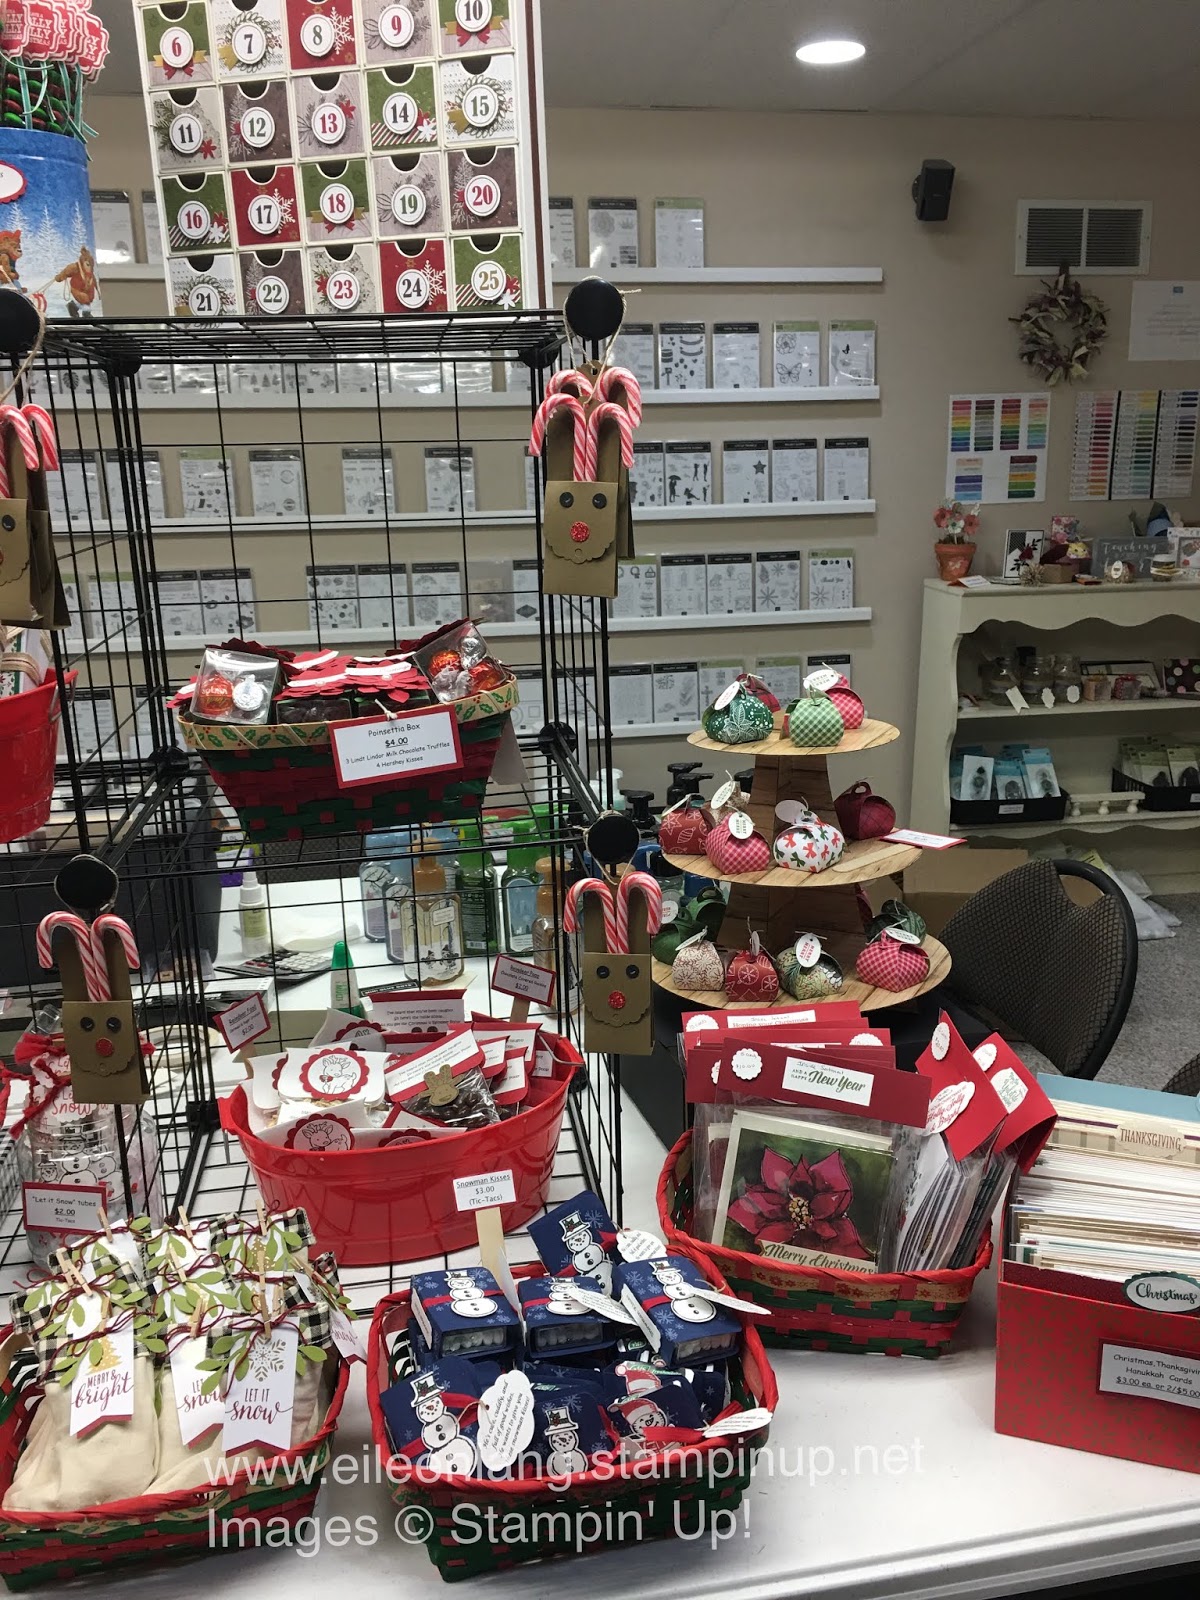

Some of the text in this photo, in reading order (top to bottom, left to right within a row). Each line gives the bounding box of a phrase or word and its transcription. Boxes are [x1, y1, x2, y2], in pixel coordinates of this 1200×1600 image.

[464, 0, 483, 22] 10
[312, 24, 323, 46] 8
[391, 15, 402, 36] 9
[171, 37, 182, 57] 6
[243, 33, 254, 54] 7
[390, 102, 409, 124] 14
[470, 95, 490, 117] 15
[178, 123, 194, 144] 11
[248, 117, 266, 138] 12
[320, 113, 338, 134] 13
[328, 193, 346, 213] 18
[400, 194, 418, 214] 19
[472, 184, 494, 206] 20
[185, 210, 202, 230] 16
[256, 204, 272, 224] 17
[334, 280, 354, 299] 23
[402, 278, 422, 298] 24
[478, 270, 500, 290] 25
[196, 292, 212, 312] 21
[262, 284, 282, 302] 22
[368, 726, 404, 737] Poinsettia
[385, 737, 408, 748] $4.00
[399, 746, 426, 755] Chocolate
[427, 742, 450, 750] Truffles
[382, 758, 404, 768] Hershey
[808, 1070, 866, 1093] New Year
[1120, 1128, 1182, 1152] THANKSGIVING
[456, 1174, 510, 1188] Snowman Kisses
[476, 1186, 494, 1194] $3.00
[469, 1194, 502, 1206] (Tic-Tacs)
[54, 1208, 76, 1216] $2.00
[764, 1243, 808, 1266] Merry
[1136, 1282, 1198, 1304] Christmas
[87, 1371, 110, 1388] MERRY
[1116, 1376, 1140, 1386] $3.00
[1126, 1366, 1192, 1384] Hanukkah Cards
[71, 1371, 134, 1412] bright
[244, 1388, 270, 1402] LET IT
[225, 1400, 294, 1424] snow
[494, 1396, 505, 1419] cuddly,
[502, 1428, 511, 1446] wants
[512, 1416, 524, 1446] snowman
